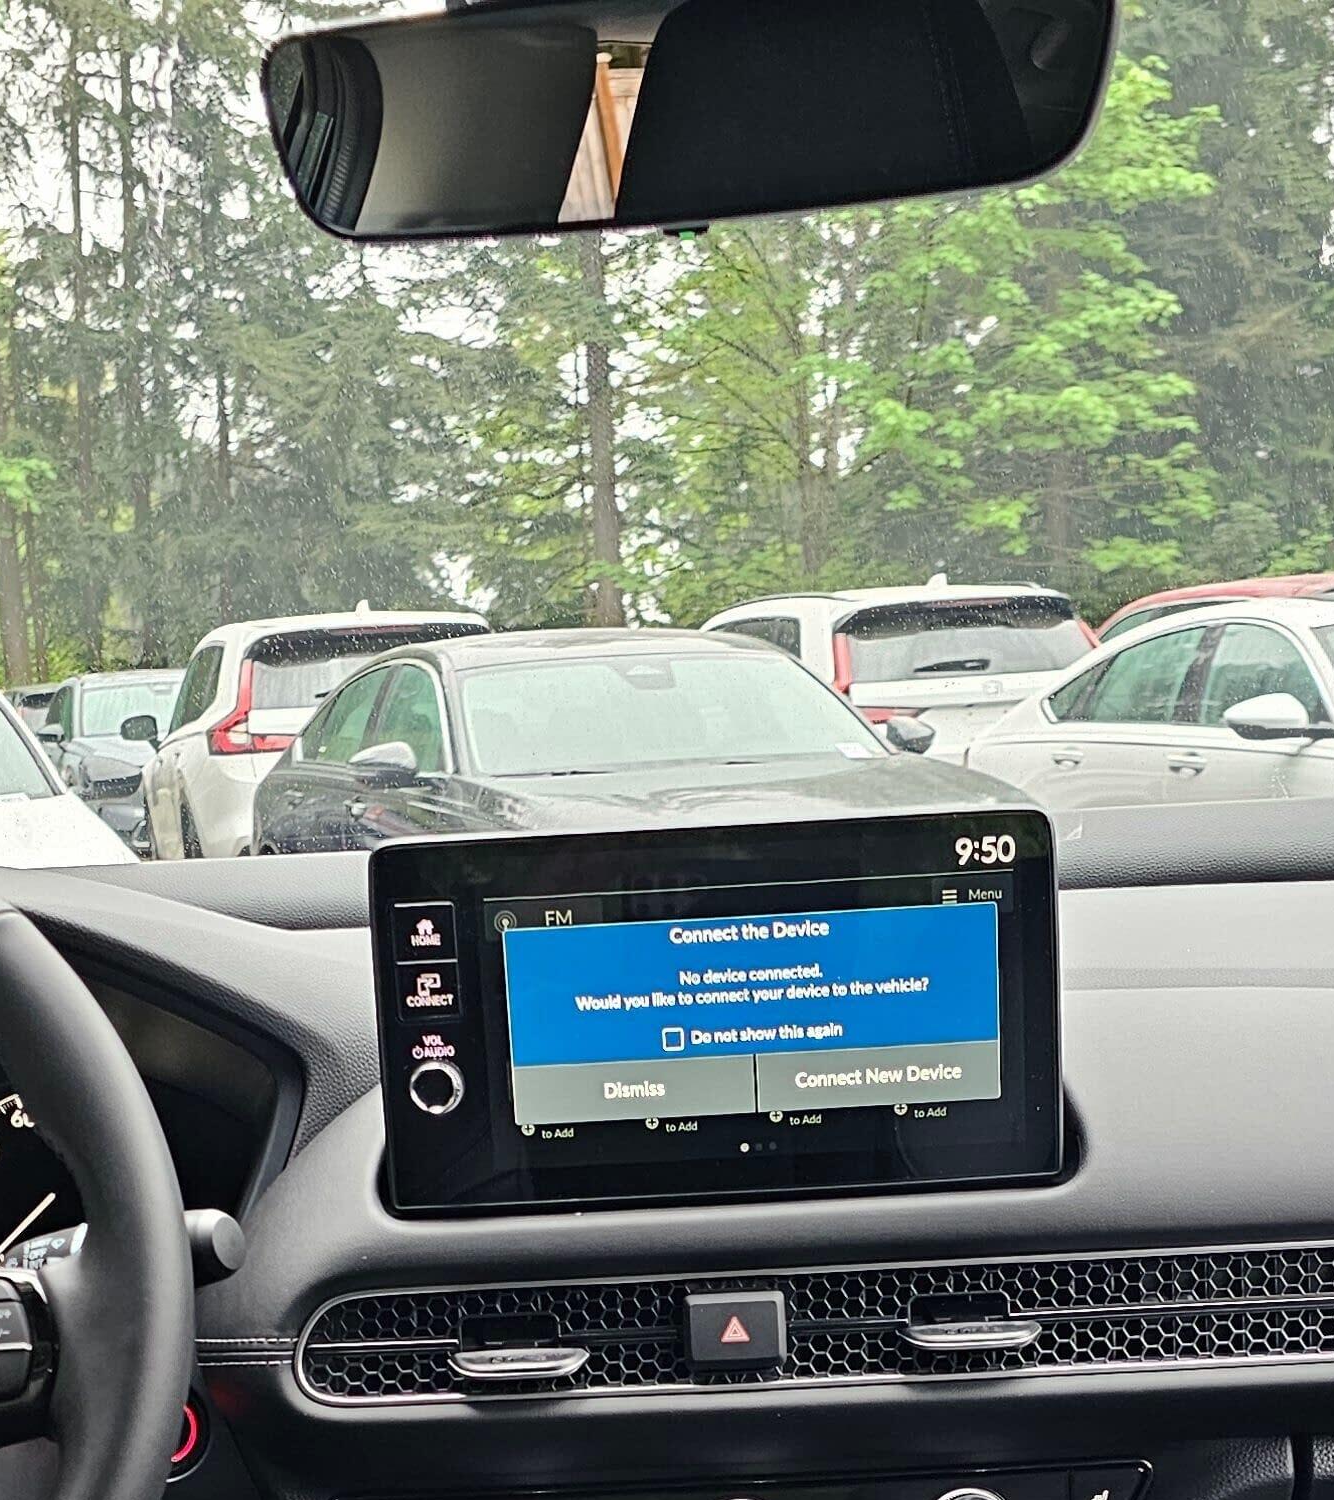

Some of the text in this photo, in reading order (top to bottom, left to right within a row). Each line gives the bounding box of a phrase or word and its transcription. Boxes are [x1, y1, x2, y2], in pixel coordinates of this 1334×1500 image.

[955, 834, 1015, 866] 9:50
[969, 889, 1003, 900] Menu
[545, 910, 573, 926] FM
[669, 920, 830, 944] Connect the Device
[411, 934, 441, 946] HOME
[679, 963, 823, 986] No device connected.
[406, 994, 453, 1007] CONNECT
[575, 977, 929, 1011] Would you like to connect your device to the vehicle?
[691, 1022, 843, 1045] Do not show this again
[422, 1035, 444, 1046] VOL
[425, 1045, 455, 1058] AUDIO
[795, 1064, 963, 1088] Connect New Device
[603, 1081, 666, 1099] Dismiss
[914, 1107, 947, 1119] to Add
[666, 1121, 697, 1132] to Add
[789, 1114, 821, 1126] to Add
[541, 1128, 574, 1140] to Add
